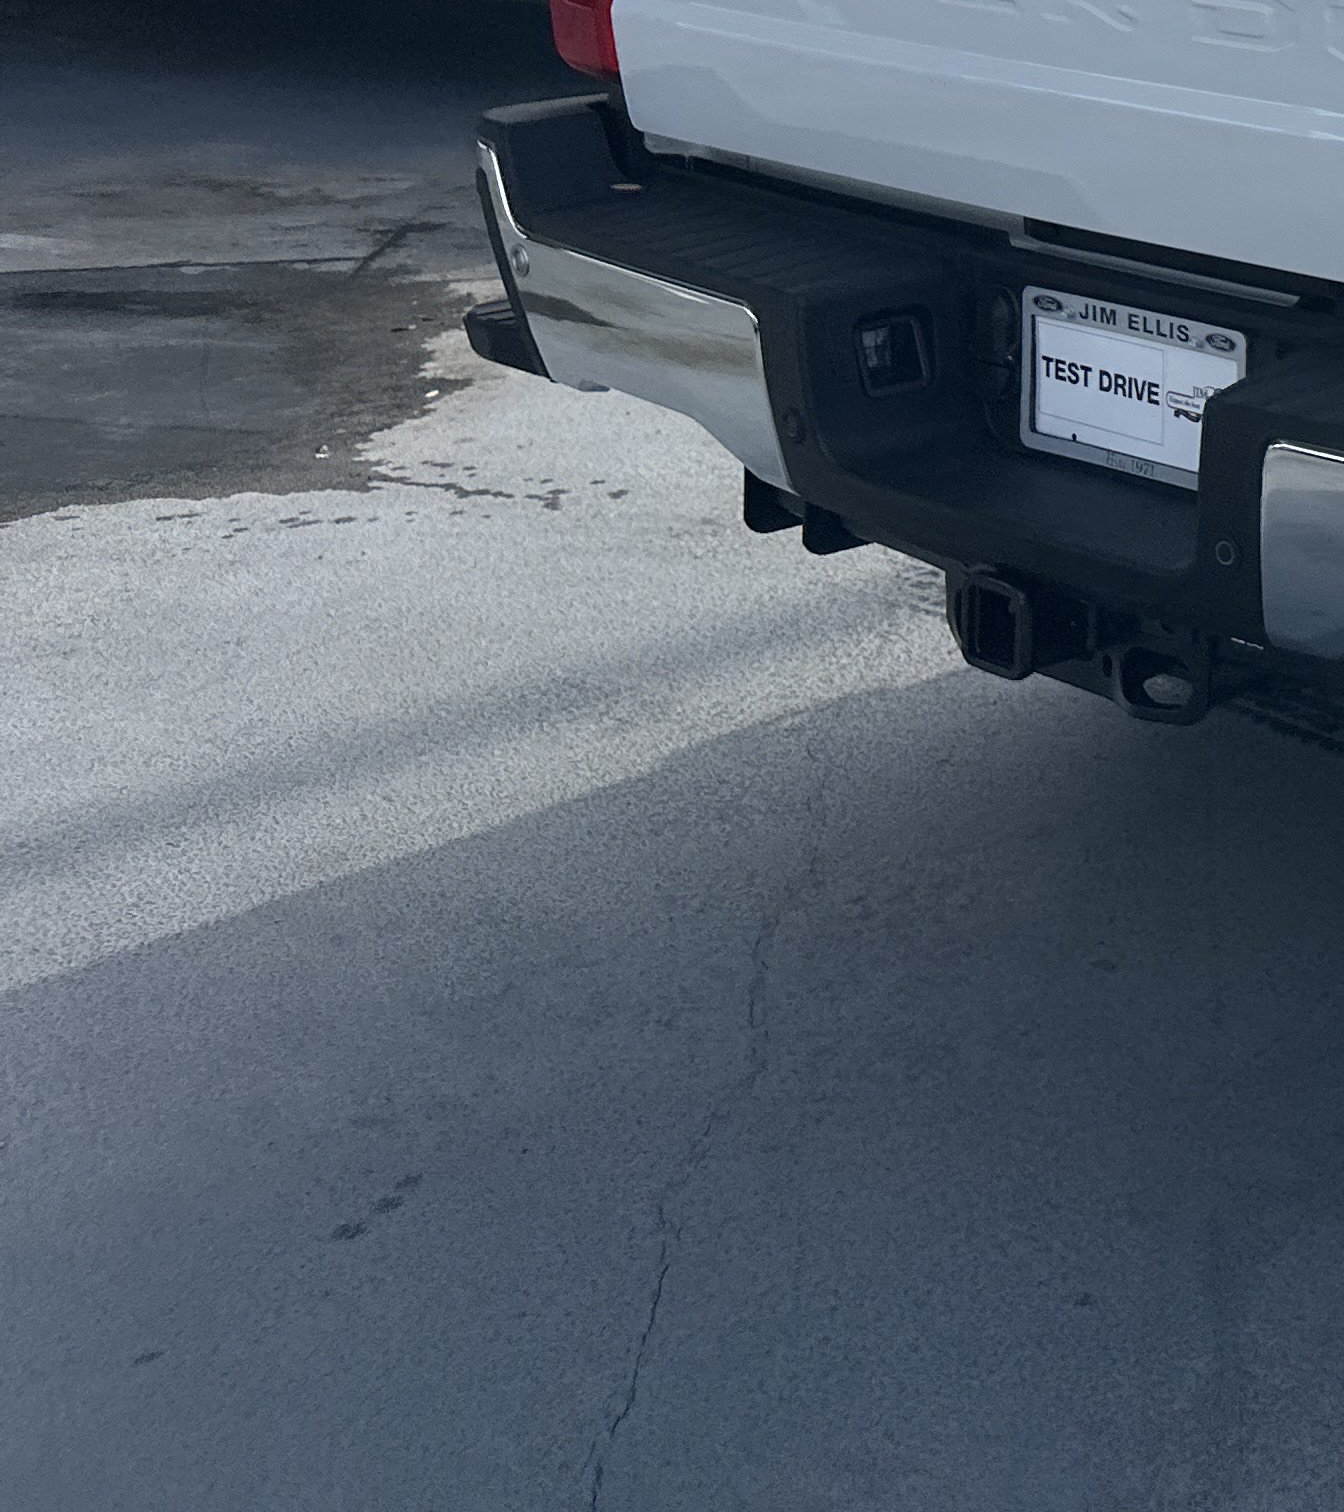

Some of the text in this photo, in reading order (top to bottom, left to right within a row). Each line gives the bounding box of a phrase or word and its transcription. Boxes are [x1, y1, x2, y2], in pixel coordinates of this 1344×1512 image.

[1079, 303, 1190, 343] JIM ELLIS
[1041, 355, 1093, 387] TEST
[1099, 369, 1160, 406] DRIVE
